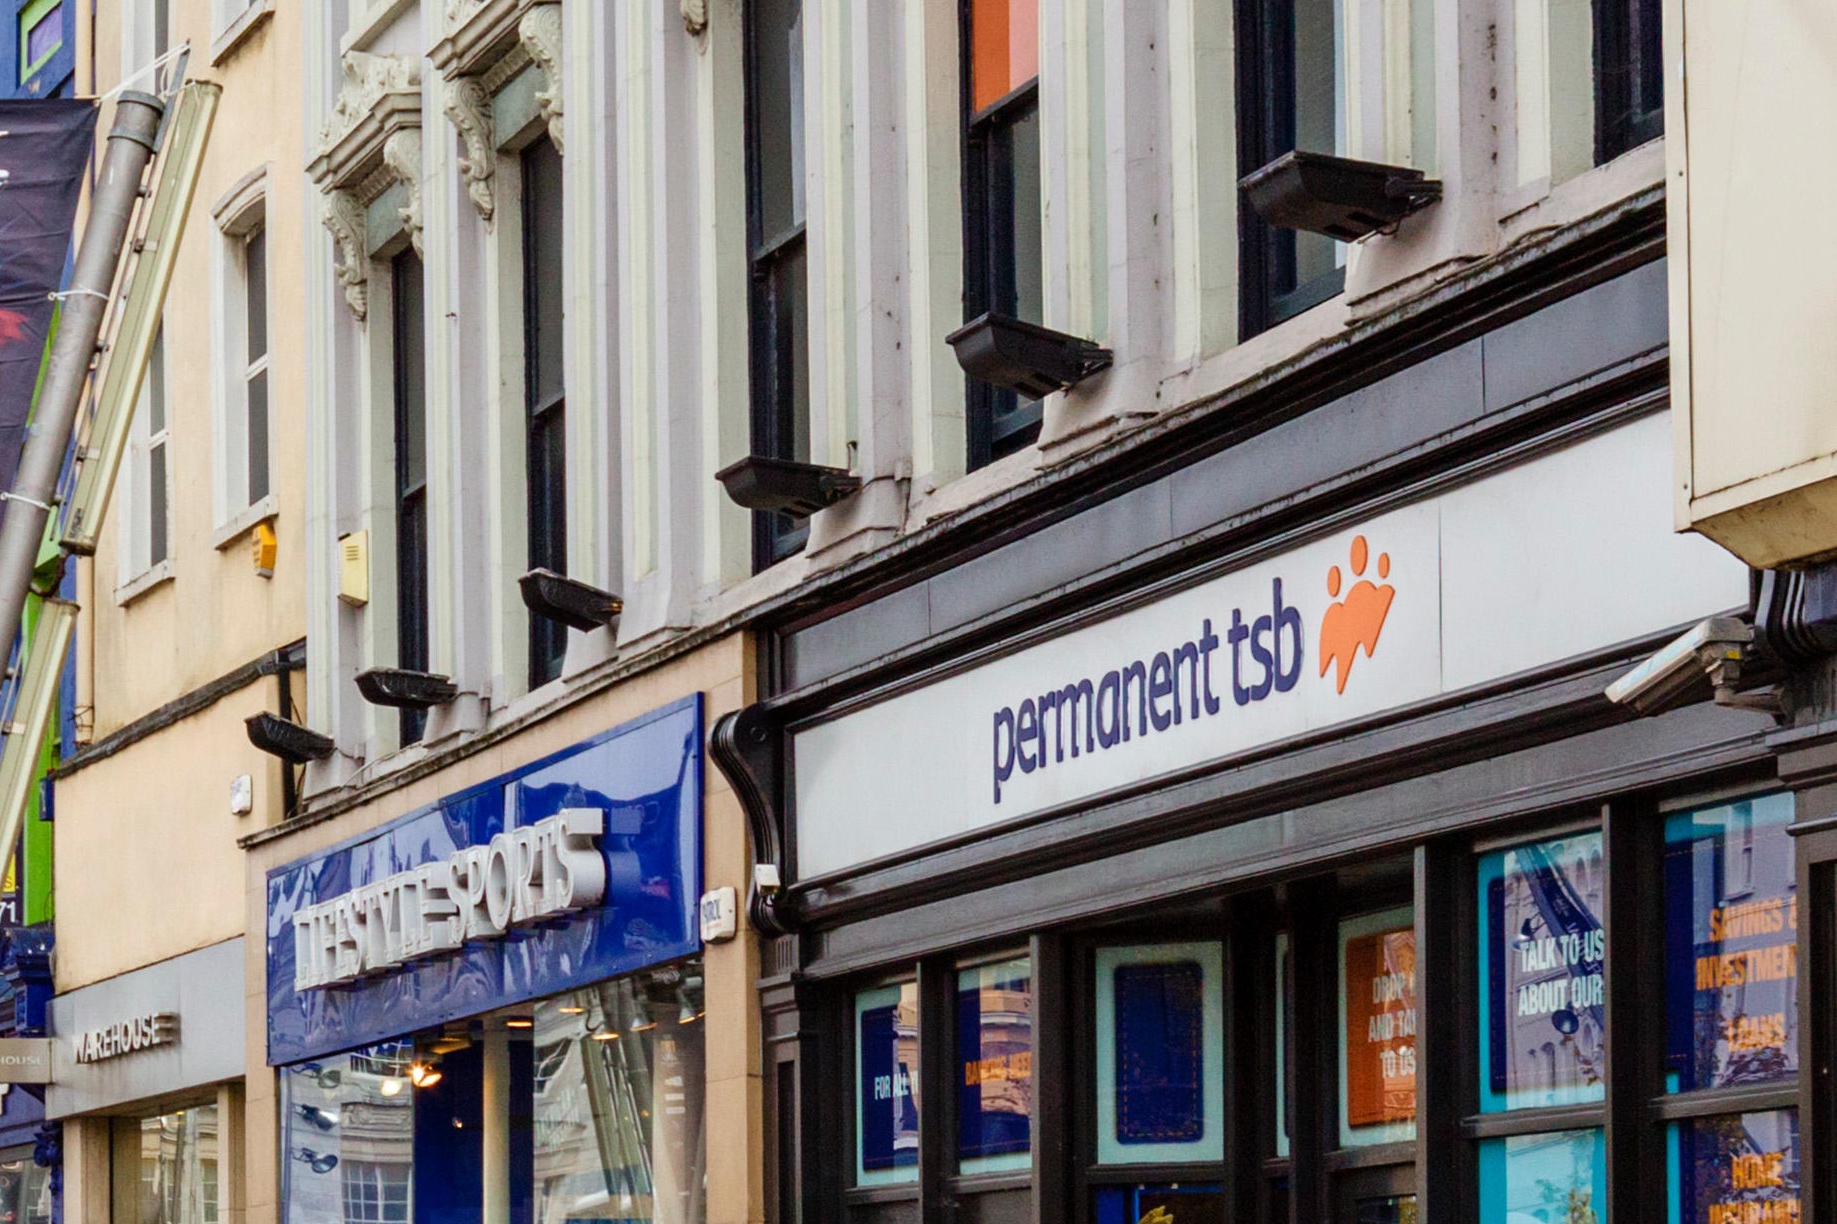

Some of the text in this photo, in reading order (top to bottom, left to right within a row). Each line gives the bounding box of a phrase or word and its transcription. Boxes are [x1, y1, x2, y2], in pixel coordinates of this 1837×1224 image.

[993, 577, 1303, 805] permanent tsb
[293, 808, 601, 992] LIFESTYLE SPORTS
[1708, 897, 1783, 943] SAVINGS
[1521, 929, 1604, 972] TALK TO US
[1373, 973, 1404, 1004] DROP
[1518, 974, 1604, 1017] ABOUT OUR
[73, 1014, 168, 1064] WAREHOUSE
[1368, 1013, 1394, 1043] AND
[1726, 1013, 1786, 1052] LOANS
[1380, 1052, 1396, 1078] TO
[875, 1075, 891, 1100] FOR
[1732, 1151, 1783, 1190] HOME
